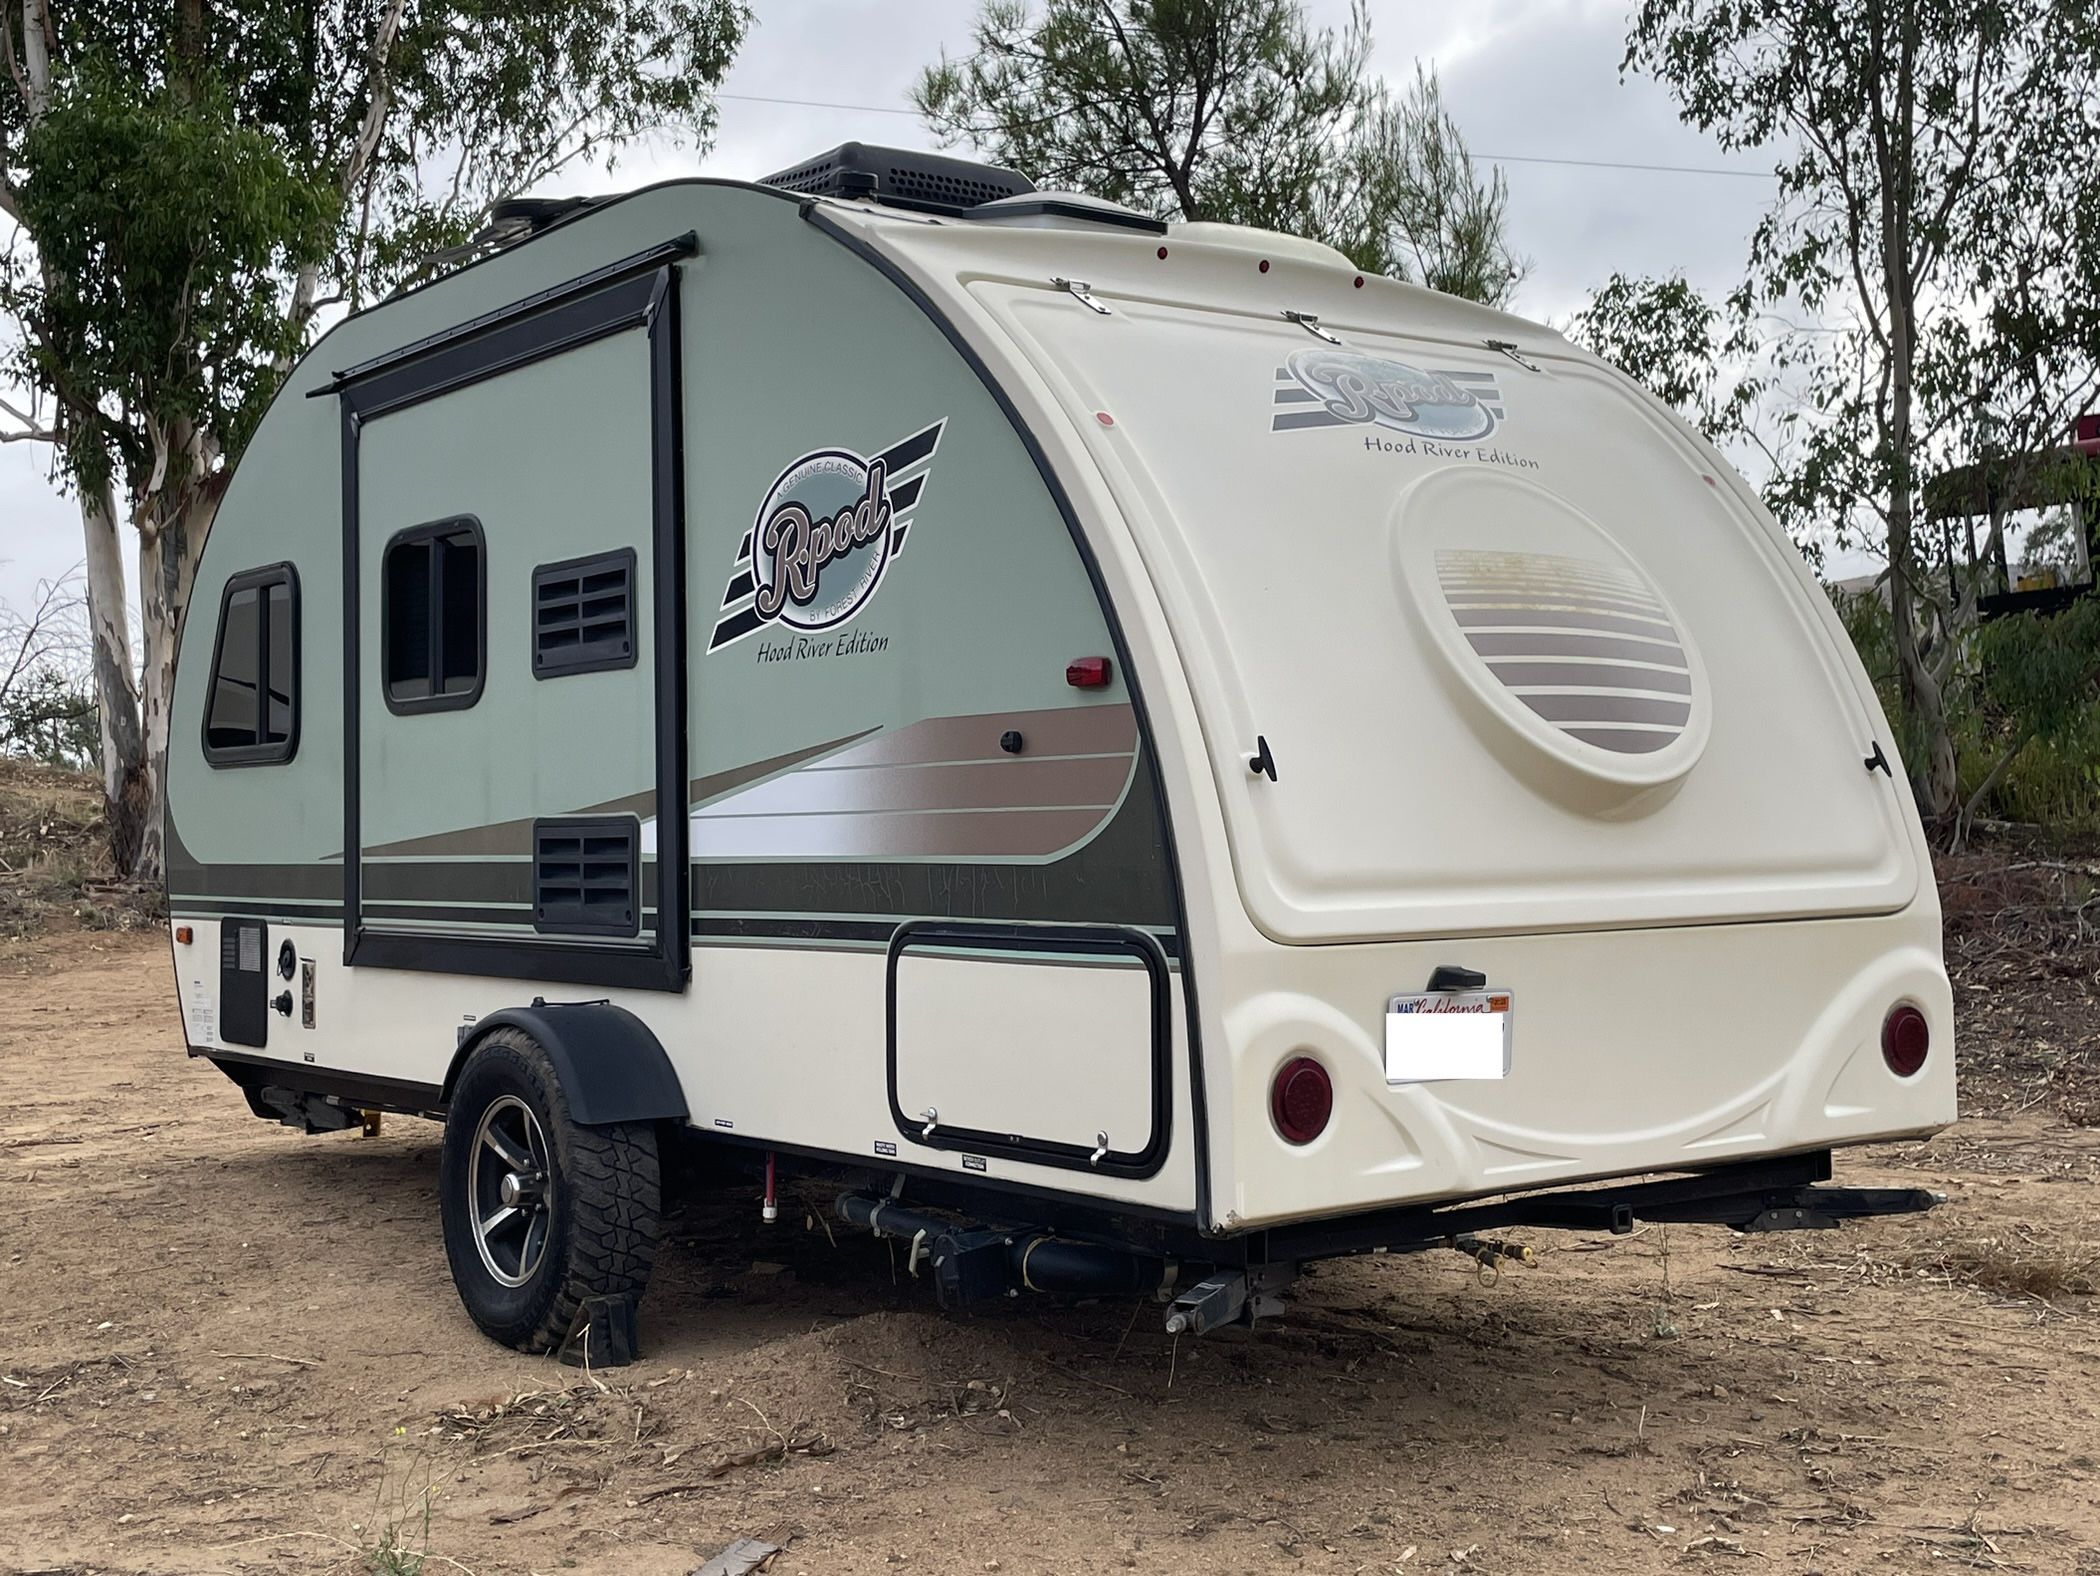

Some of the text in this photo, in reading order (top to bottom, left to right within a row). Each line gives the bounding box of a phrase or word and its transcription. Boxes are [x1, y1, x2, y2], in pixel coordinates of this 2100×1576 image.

[1364, 436, 1540, 471] Hood River Edition
[782, 462, 822, 493] GENUINE
[824, 461, 864, 484] CLASSIC
[809, 551, 881, 622] BY FOREST RIVER
[756, 628, 889, 664] Hood River Edition
[1397, 1003, 1414, 1013] MAR
